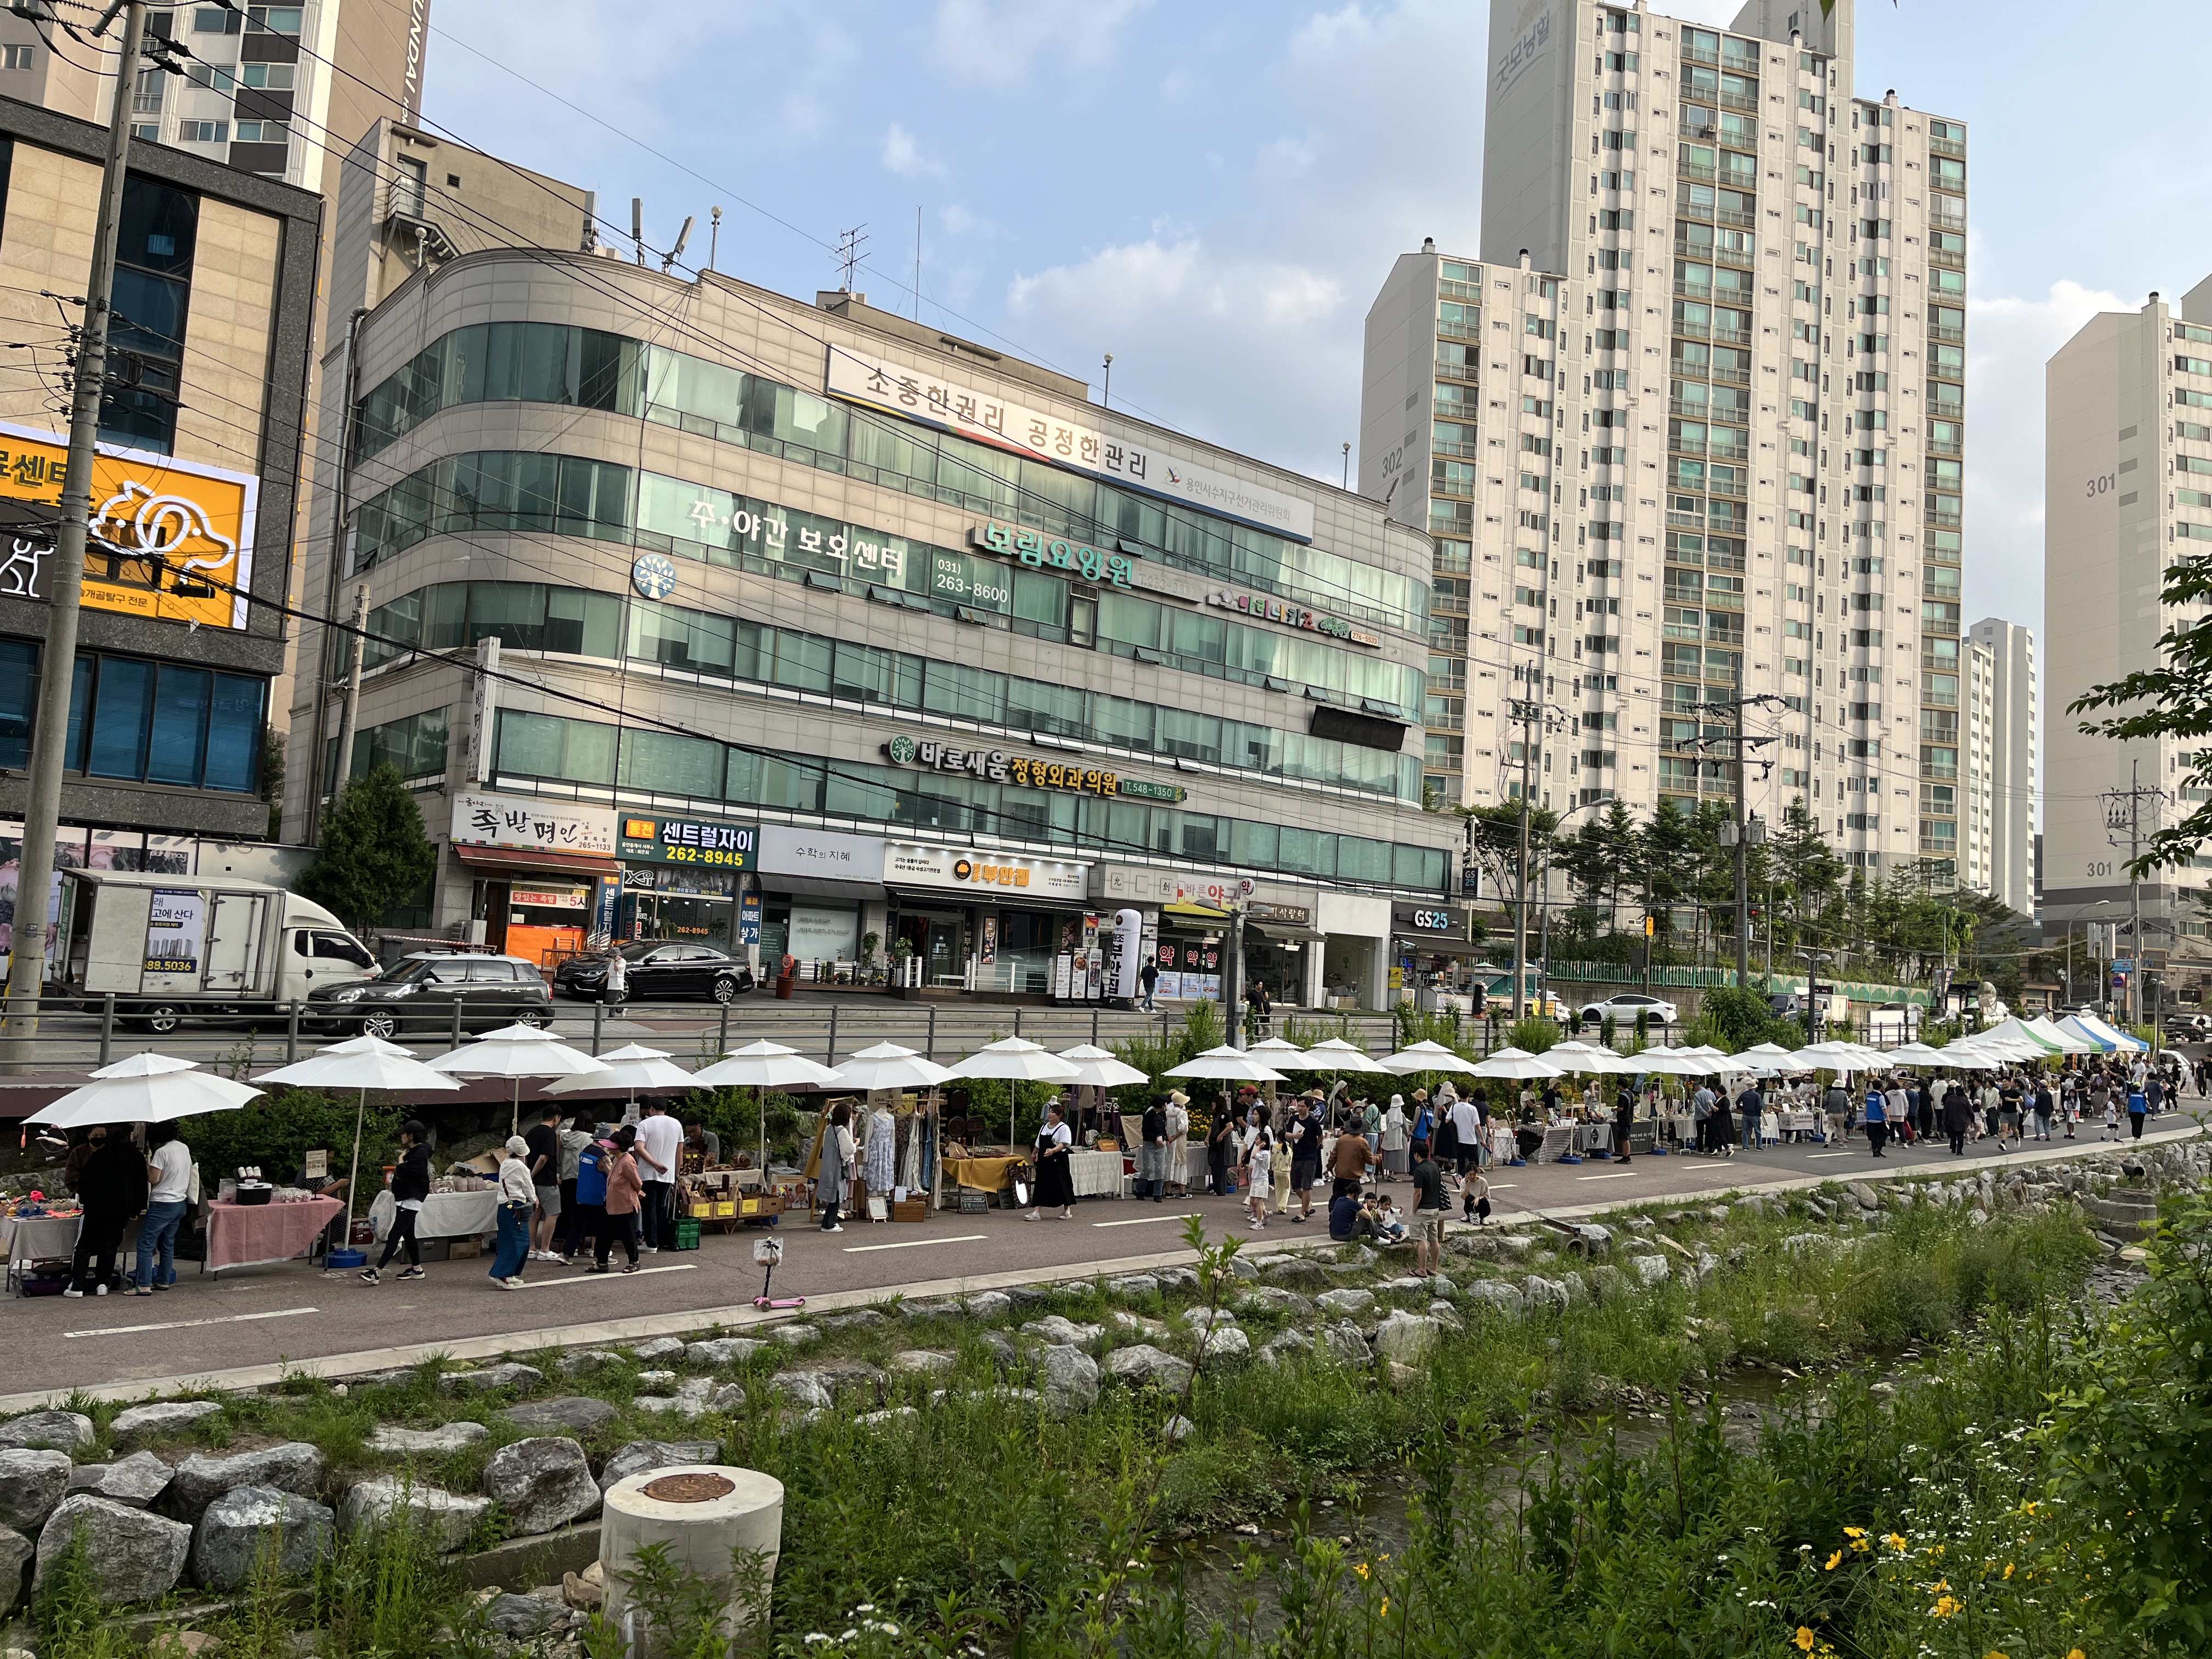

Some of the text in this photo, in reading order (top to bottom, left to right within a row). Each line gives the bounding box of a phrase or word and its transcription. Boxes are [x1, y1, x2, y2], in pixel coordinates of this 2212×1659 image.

[408, 0, 423, 93] UNDAI
[867, 368, 1004, 435] 소중한권리
[1383, 447, 1402, 478] 302
[2086, 472, 2115, 498] 301
[1186, 478, 1290, 522] 용인시수지구선거관리위원회
[799, 528, 903, 576] 보호센터
[985, 521, 1133, 590] 보림요양원
[937, 558, 961, 574] 031)
[936, 574, 1007, 603] 263-8600
[128, 597, 148, 607] 전문
[1238, 595, 1315, 630] 마리나키즈
[1352, 632, 1378, 645] 276-5533
[921, 741, 1117, 797] 바로새움 정형외과 의원
[1126, 782, 1172, 798] T.548-1350
[471, 809, 577, 844] 족발 명인
[629, 822, 753, 851] 동천 센트럴자이
[579, 842, 611, 851] 265-1133
[795, 847, 850, 862] 수학의 지혜
[666, 846, 743, 866] 262-8945
[983, 865, 1030, 887] 부안집
[2087, 861, 2112, 877] 301
[1242, 881, 1250, 894] 약
[1465, 878, 1475, 887] 25
[515, 893, 555, 903] 맛있는 족발
[569, 896, 588, 908] 5시
[174, 909, 194, 920] 산다
[742, 910, 759, 922] 아파트
[1414, 910, 1448, 929] GS25
[677, 926, 709, 935] 262-8945
[741, 927, 759, 939] 상가
[1159, 945, 1175, 966] 약
[1187, 950, 1198, 966] 약
[1206, 952, 1218, 967] 약
[1109, 944, 1123, 995] 부안집
